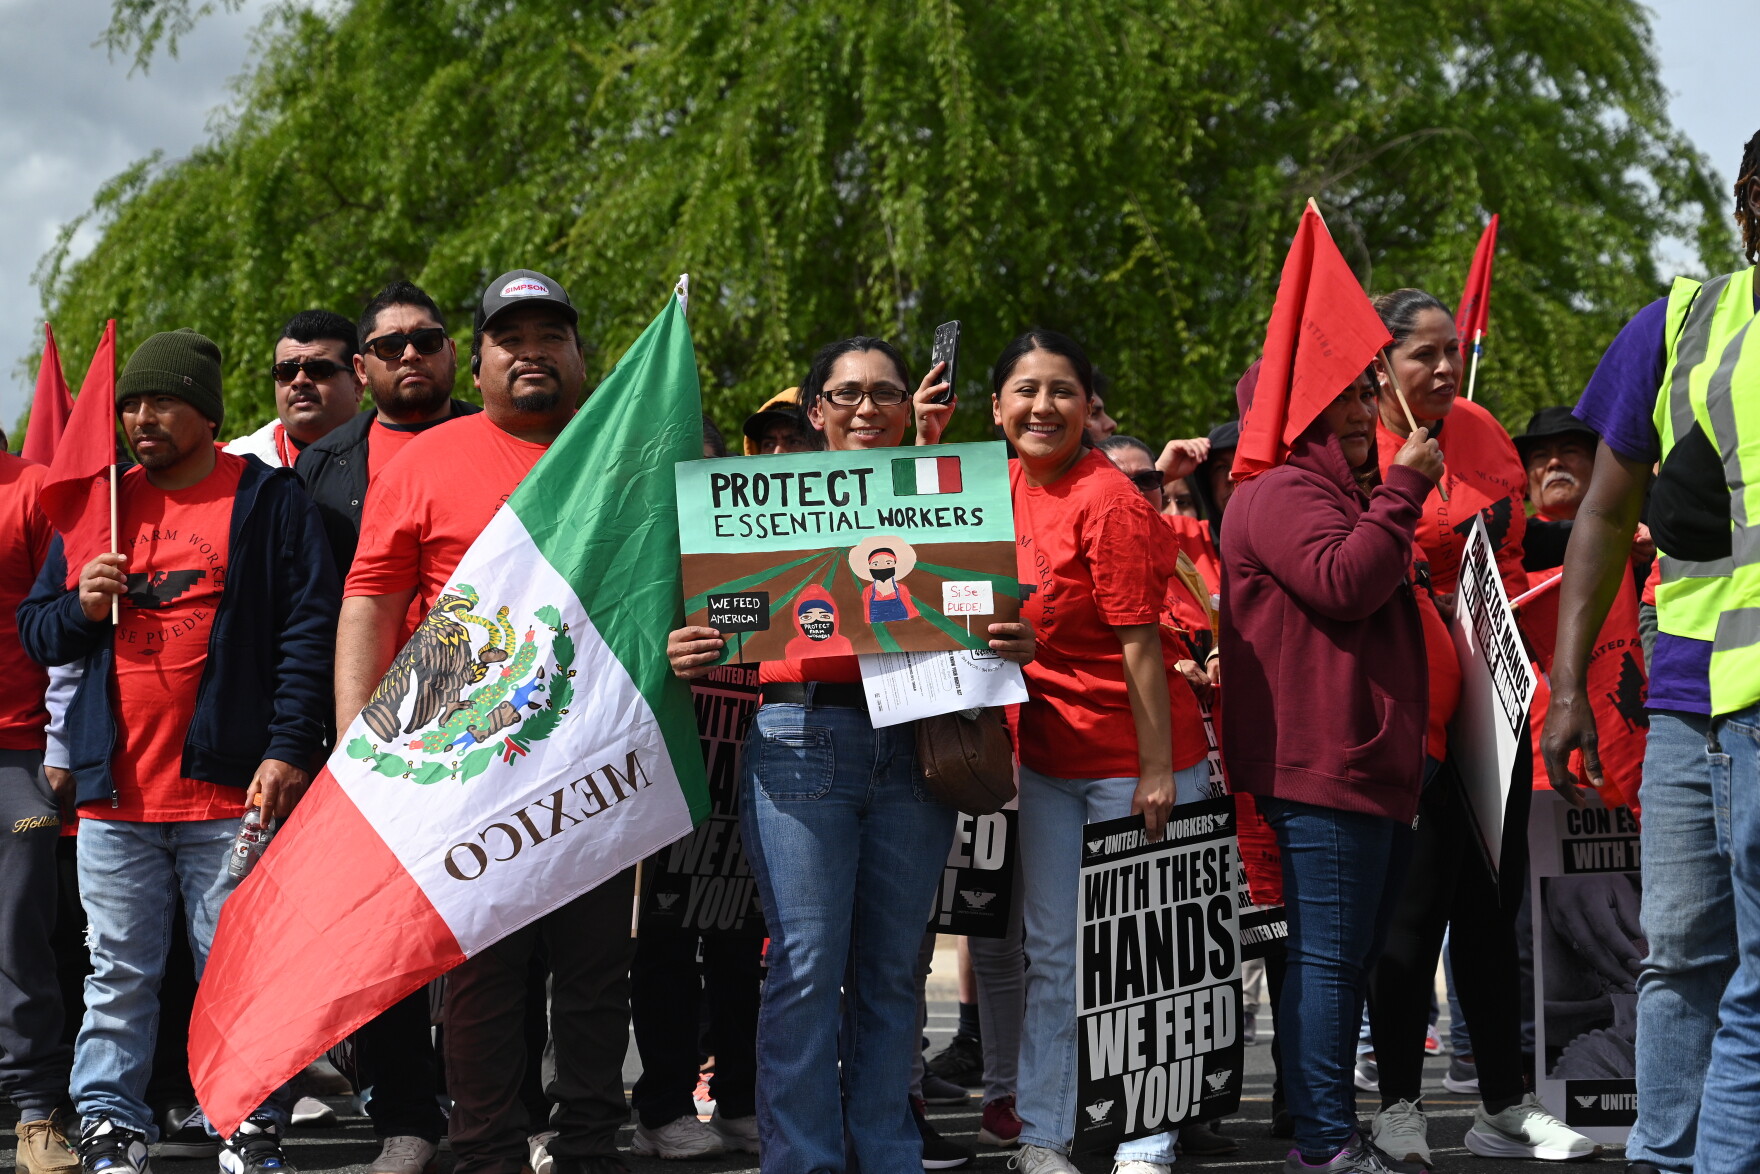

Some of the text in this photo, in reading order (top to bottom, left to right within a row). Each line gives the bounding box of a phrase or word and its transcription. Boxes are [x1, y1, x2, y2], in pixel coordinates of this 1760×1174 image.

[711, 468, 874, 508] PROTECT
[714, 506, 984, 538] ESSENTIAL WORKERS
[129, 529, 225, 588] FARM WORKE
[710, 597, 760, 609] WE FEED
[947, 602, 982, 613] PUEDE!
[1035, 546, 1056, 629] ORKERS
[118, 627, 137, 643] SE
[710, 614, 758, 624] AMERICA!
[1471, 530, 1530, 703] CON ESTAS MANOS
[1630, 638, 1642, 649] FA
[746, 669, 759, 687] FA
[1494, 656, 1520, 730] HANDS
[947, 810, 1008, 871] ED
[1104, 829, 1138, 856] UNITED
[1166, 814, 1214, 841] WORKERS
[1567, 807, 1611, 835] CON
[1572, 841, 1626, 870] WITH
[681, 875, 755, 930] YOU!
[1085, 845, 1231, 923] WITH THESE
[1083, 895, 1236, 1011] HANDS
[1240, 923, 1273, 946] UNITED
[1087, 984, 1237, 1082] WE FEED
[1123, 1056, 1205, 1135] YOU!
[1601, 1093, 1638, 1111] UNITE
